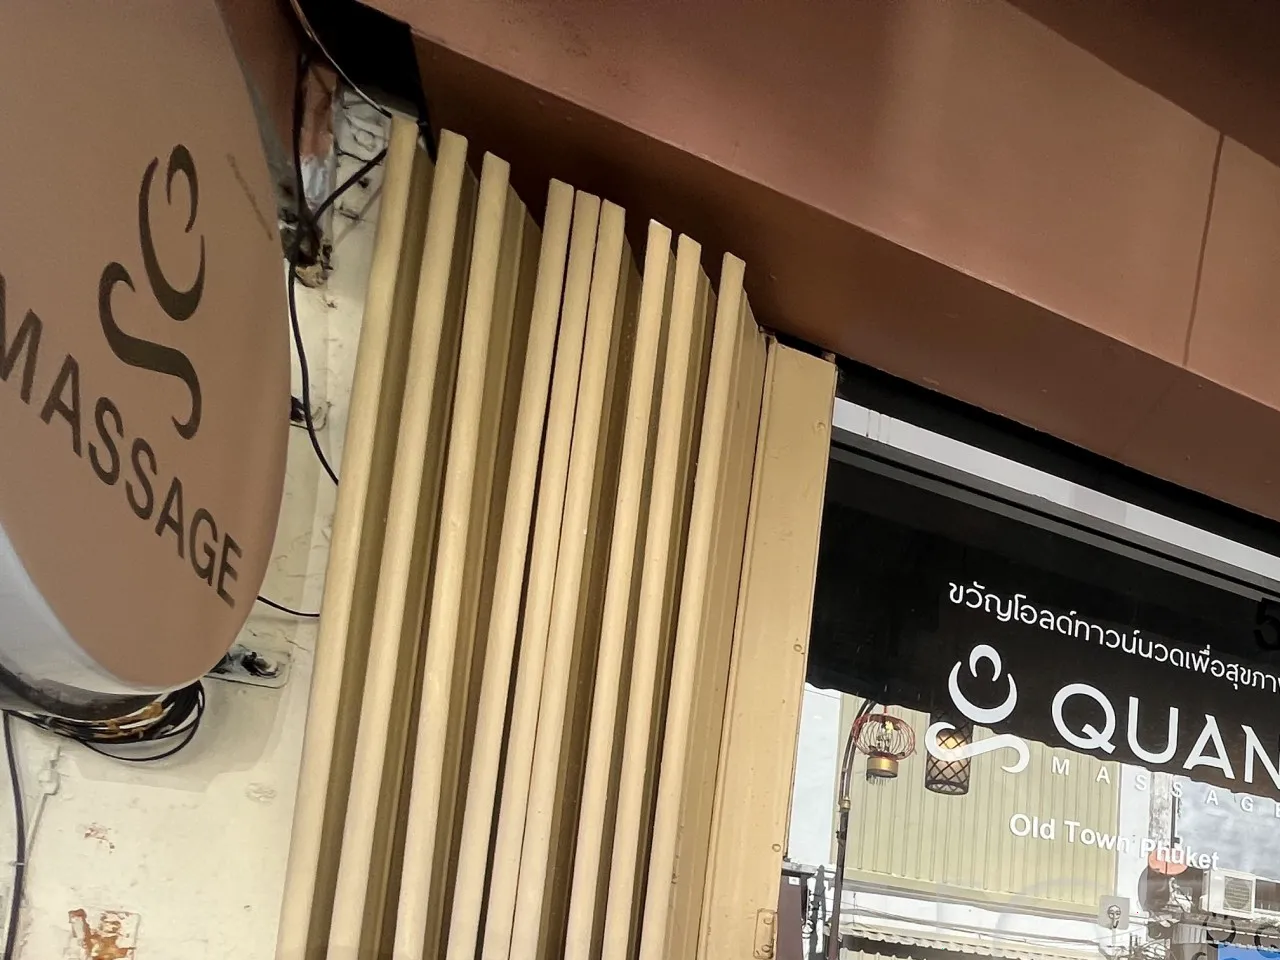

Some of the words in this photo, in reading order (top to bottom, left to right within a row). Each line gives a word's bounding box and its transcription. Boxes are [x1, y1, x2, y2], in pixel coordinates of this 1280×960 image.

[0, 275, 242, 608] MASSAGE
[1008, 813, 1056, 840] Old
[1063, 820, 1130, 853] Town
[1140, 838, 1220, 870] Phuket
